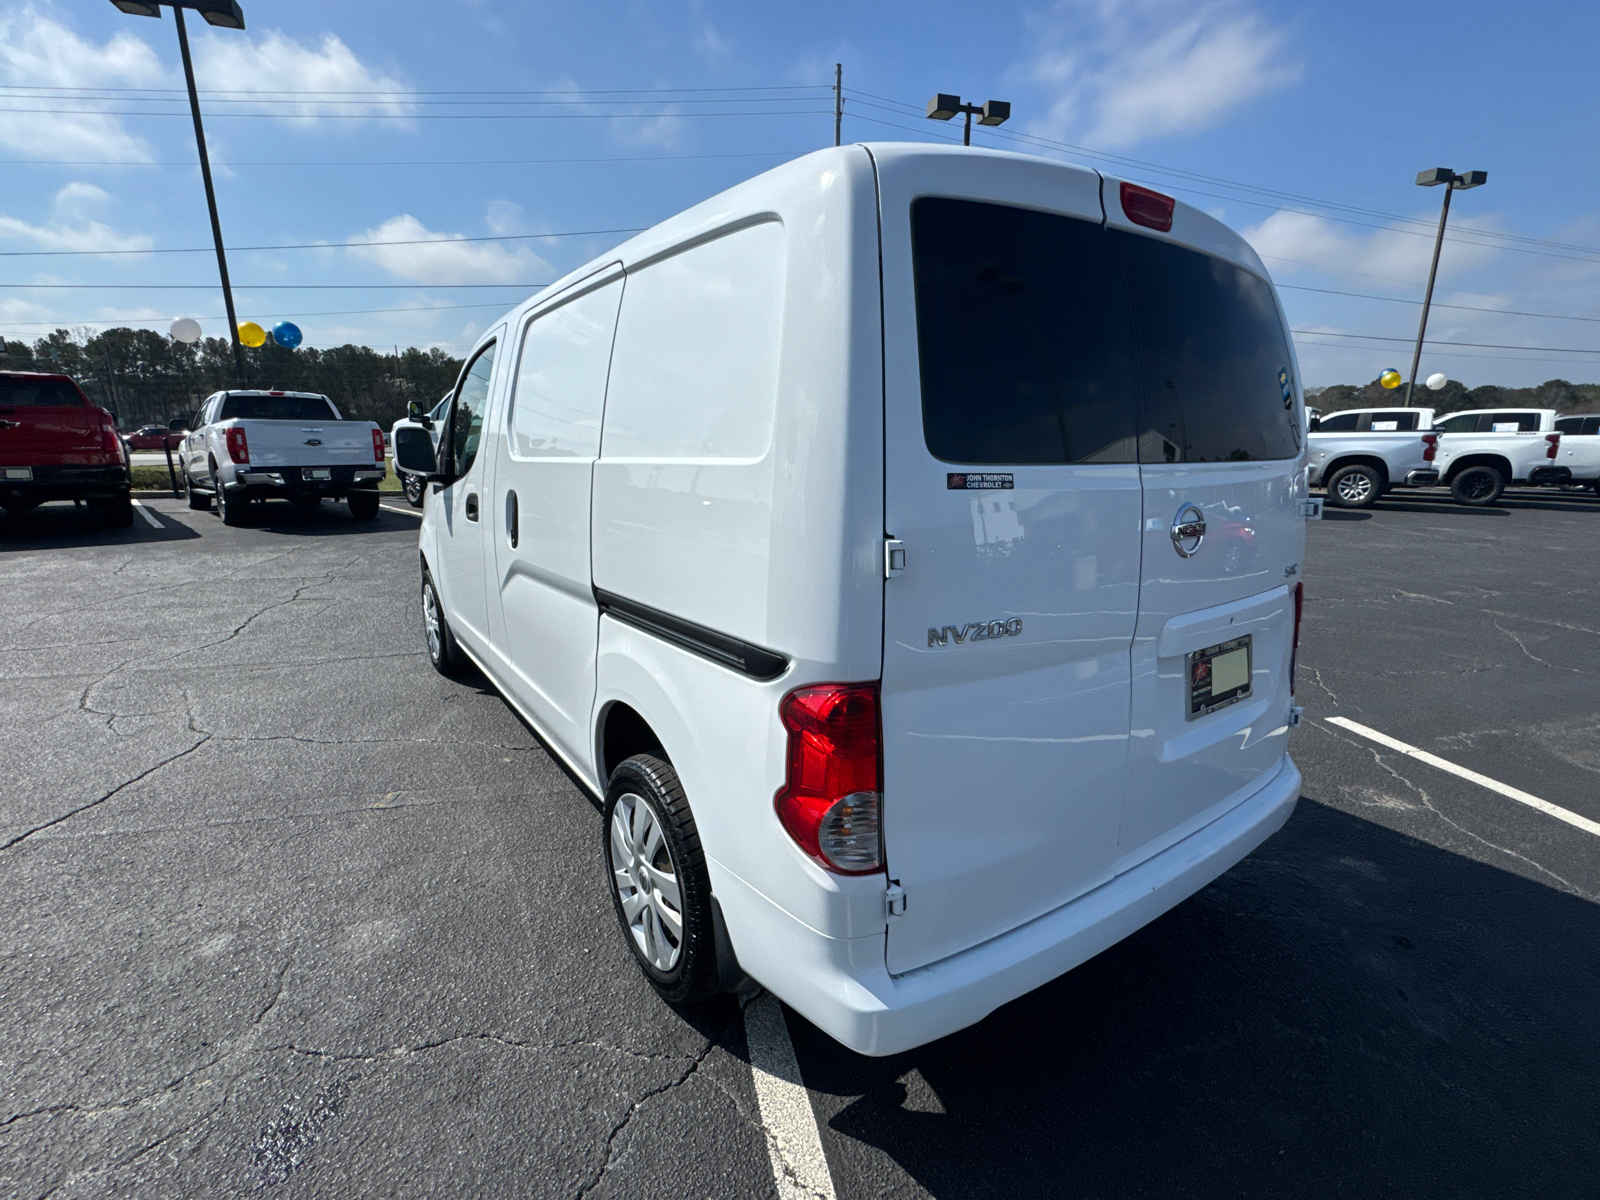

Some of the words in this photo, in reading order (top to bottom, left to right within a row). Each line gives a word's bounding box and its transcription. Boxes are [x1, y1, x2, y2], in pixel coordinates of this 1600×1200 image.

[966, 474, 982, 482] JOHN
[982, 474, 1013, 482] THORNTON
[966, 481, 1003, 489] CHEVROLET
[927, 616, 1023, 648] NV200
